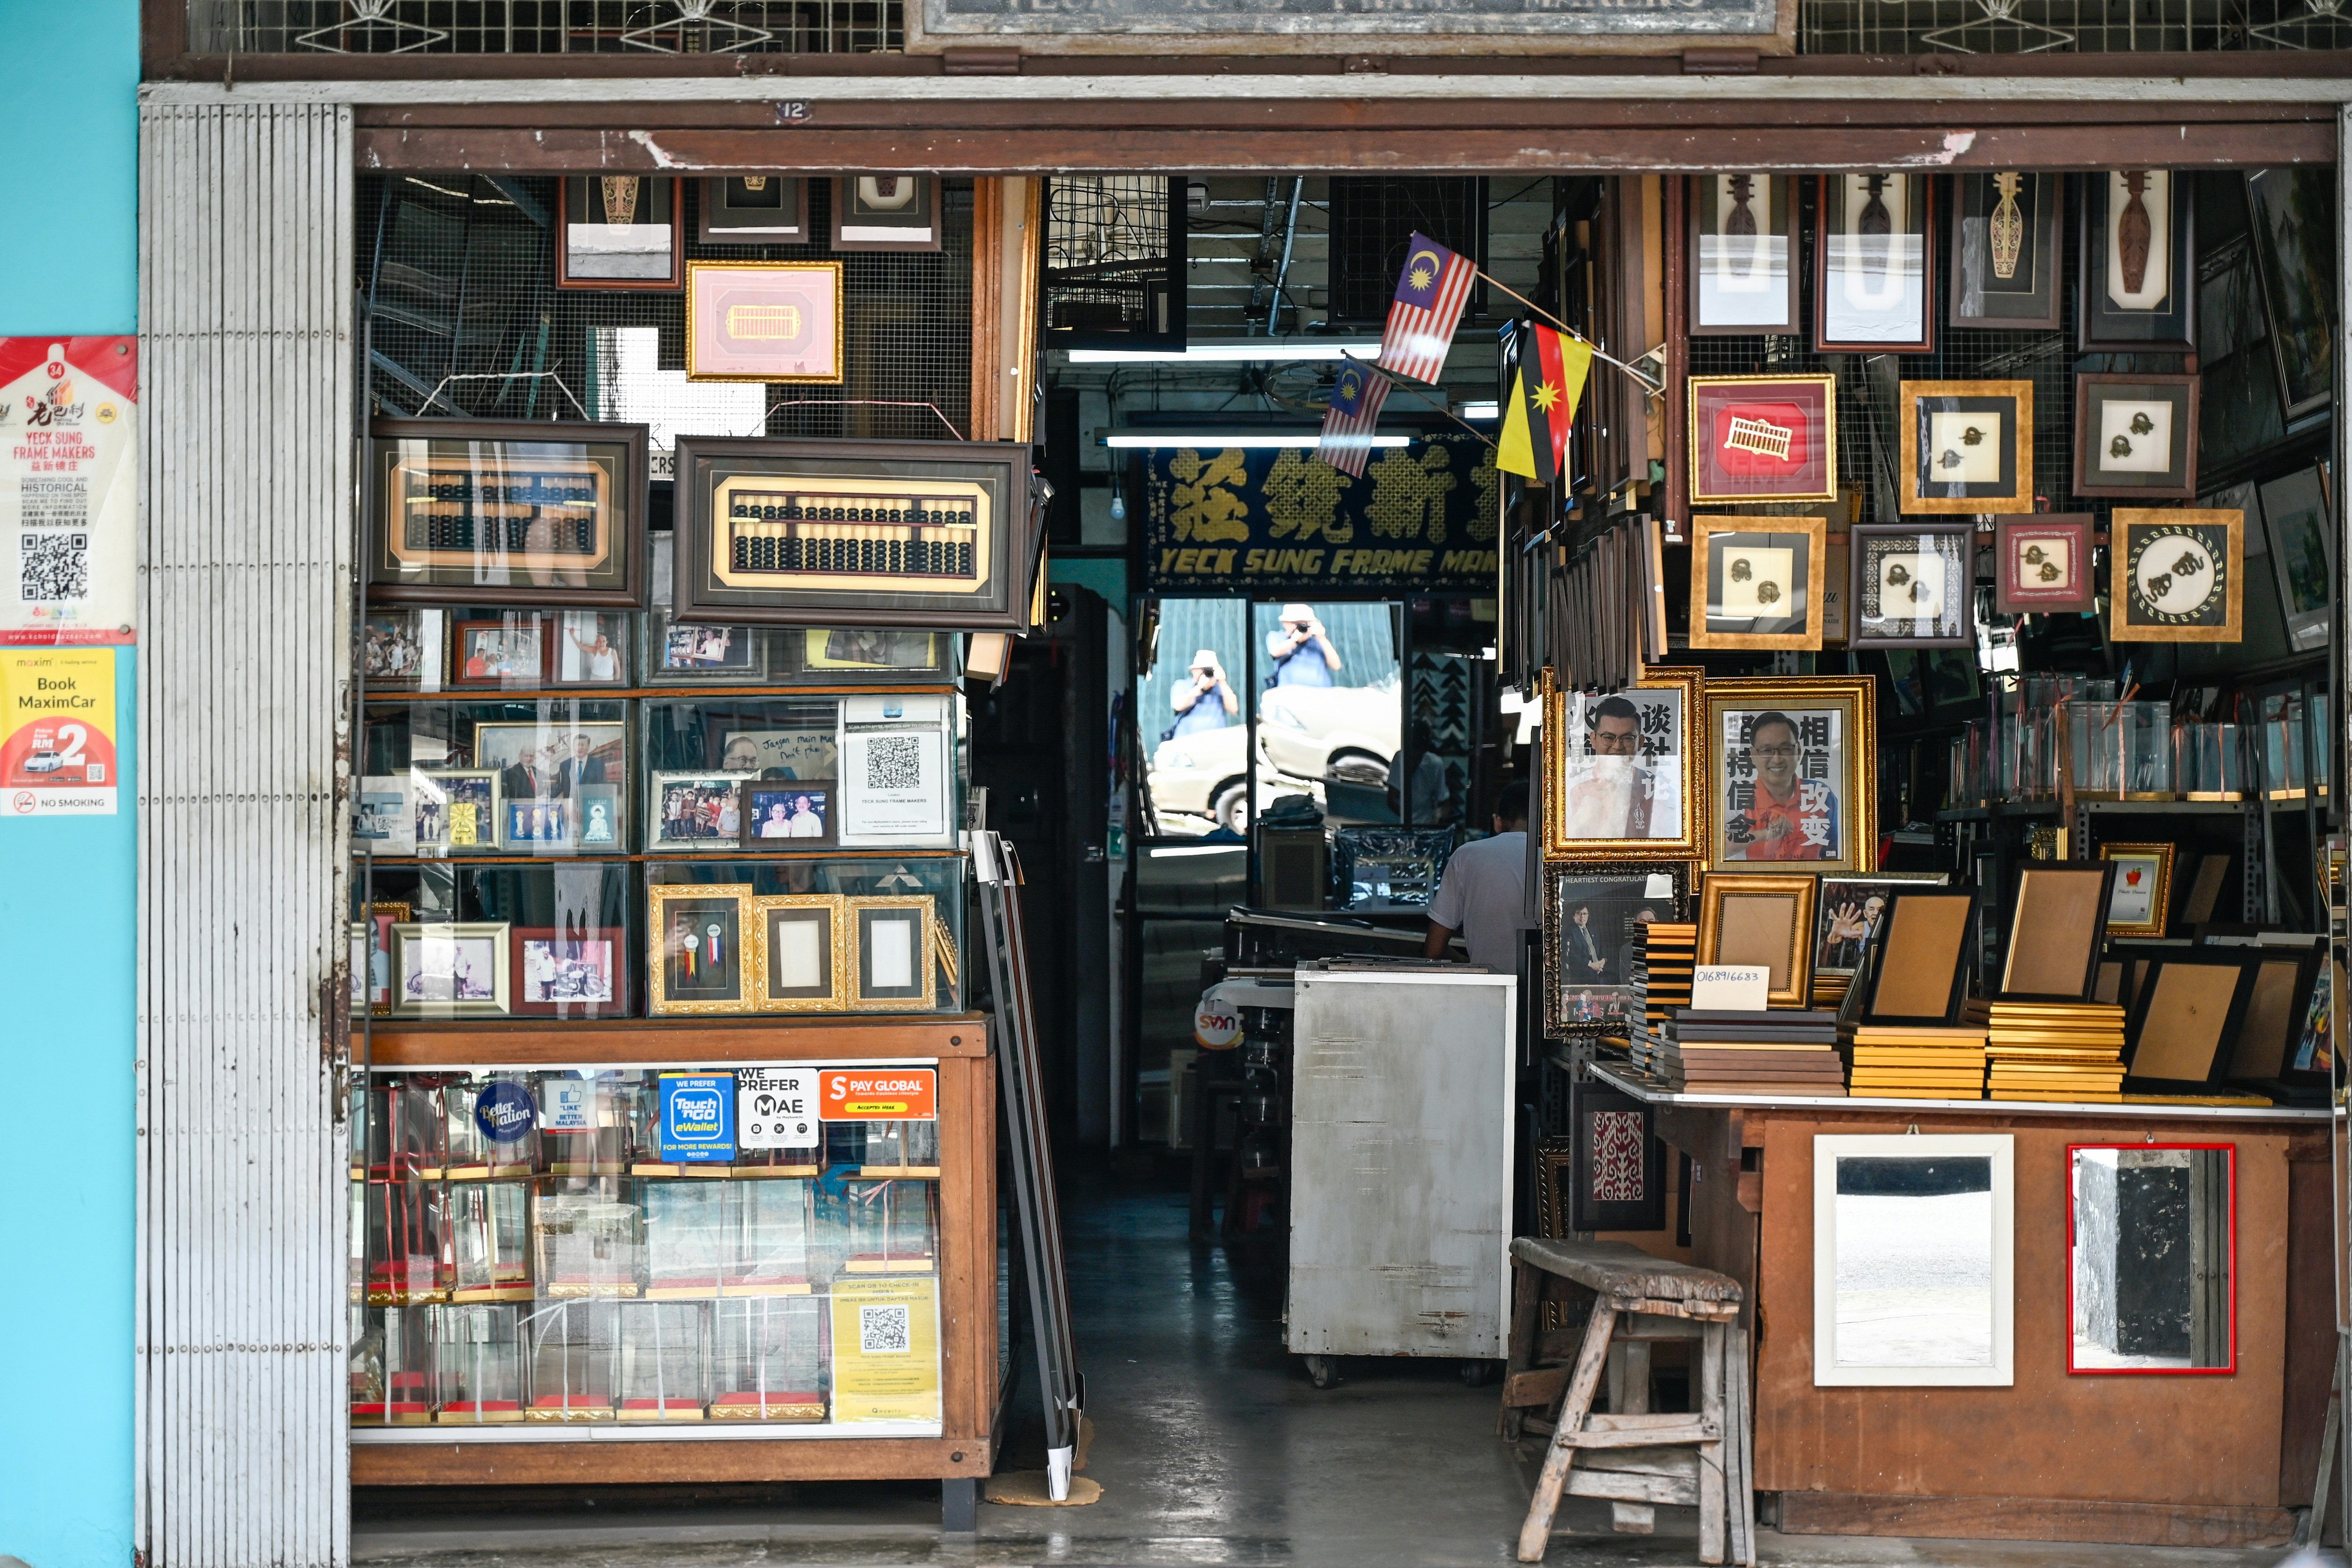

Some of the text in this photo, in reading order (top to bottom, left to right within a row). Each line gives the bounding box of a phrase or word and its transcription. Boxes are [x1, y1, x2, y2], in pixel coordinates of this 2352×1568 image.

[785, 103, 803, 117] 12
[50, 365, 62, 375] 34
[27, 432, 82, 445] YECK SUNG
[14, 446, 95, 459] FRAME MAKERS
[31, 461, 78, 471] 益新镜庄
[22, 484, 87, 492] HISTORICAL
[1158, 549, 1238, 574] YECK
[1243, 549, 1327, 574] SUNG
[1331, 549, 1434, 574] FRAME
[17, 658, 52, 667] maxim
[38, 677, 76, 691] Book
[19, 695, 96, 708] MaximCar
[32, 740, 54, 748] RM
[58, 724, 87, 766] 2
[1642, 704, 1671, 800] 谈社论
[1726, 715, 1756, 843] 坚持信念
[1800, 716, 1830, 846] 相信改变
[1697, 971, 1759, 982] 0168916683
[741, 1068, 765, 1079] WE
[739, 1079, 799, 1091] PREFER
[830, 1076, 922, 1100] S PAY GLOBAL
[675, 1098, 717, 1110] Touch
[754, 1094, 803, 1116] MAE
[480, 1102, 515, 1120] Better
[488, 1109, 531, 1128] Nation
[675, 1122, 718, 1131] eWallet
